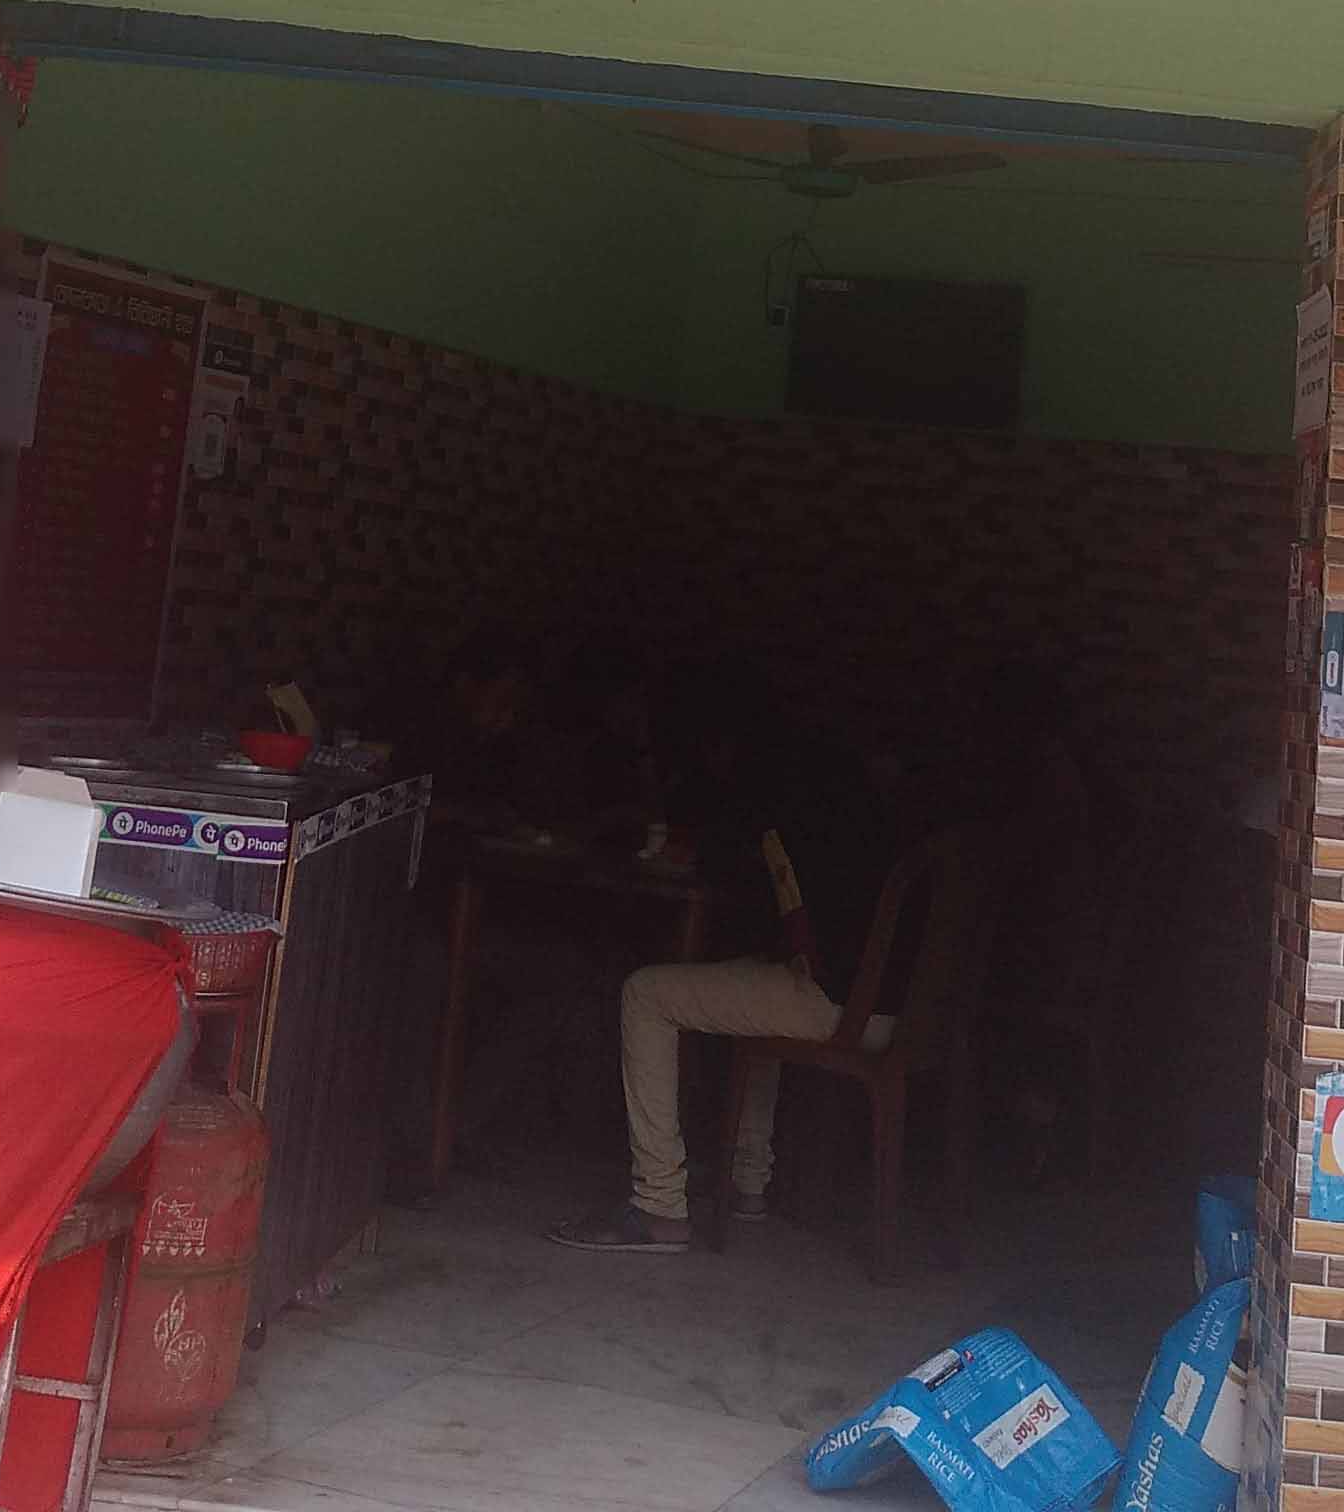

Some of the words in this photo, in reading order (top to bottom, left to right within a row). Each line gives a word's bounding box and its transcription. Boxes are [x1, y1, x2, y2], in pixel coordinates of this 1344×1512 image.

[135, 820, 187, 838] PhonePe
[1205, 1317, 1225, 1352] RICE
[925, 1430, 977, 1481] BASMATI
[927, 1451, 957, 1483] RICE
